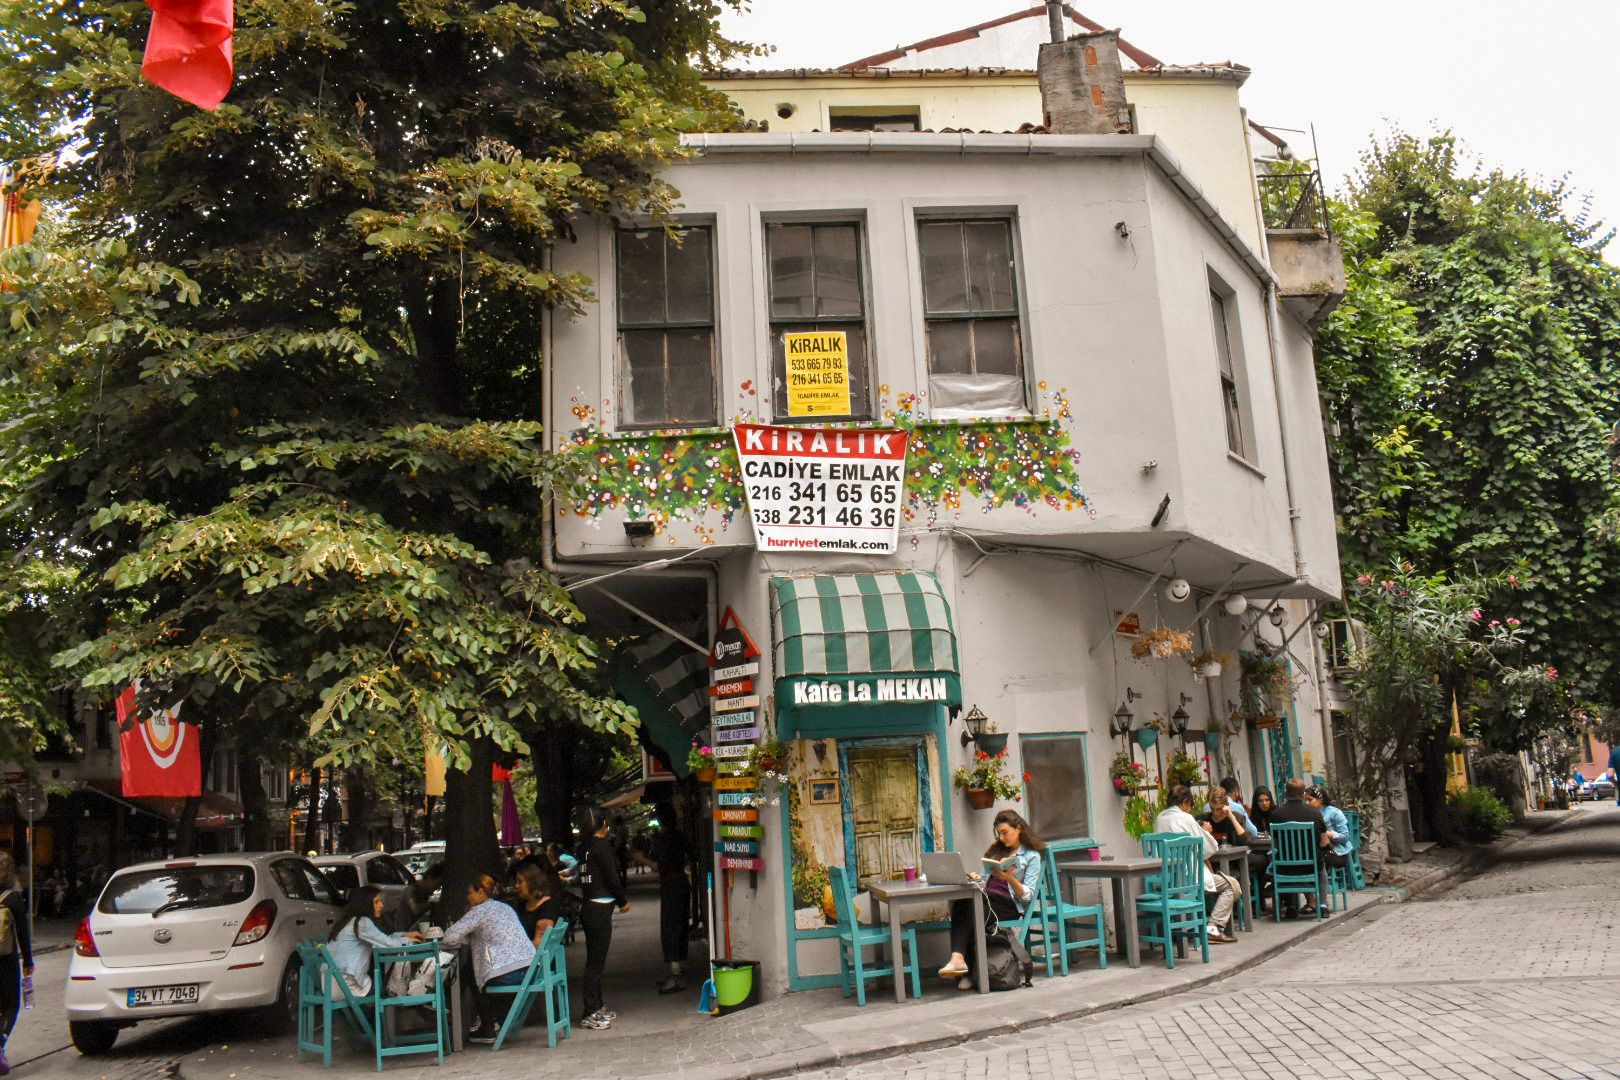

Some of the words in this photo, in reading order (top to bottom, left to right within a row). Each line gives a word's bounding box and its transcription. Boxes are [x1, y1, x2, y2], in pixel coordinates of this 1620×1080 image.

[791, 359, 806, 370] 533
[806, 358, 821, 370] 665
[822, 358, 832, 370] 79
[832, 357, 842, 369] 93
[792, 374, 806, 385] 216
[808, 373, 821, 384] 341
[823, 373, 833, 384] 65
[834, 372, 843, 384] 65
[821, 391, 840, 399] EMLAK
[829, 463, 901, 482] EMLAK
[788, 482, 827, 503] 341
[836, 483, 863, 504] 65
[870, 484, 897, 504] 65
[788, 505, 827, 526] 231
[835, 506, 863, 527] 46
[870, 507, 896, 528] 36
[767, 536, 889, 551] hurriyetemlak.com
[717, 682, 743, 695] MENEMEN
[794, 681, 842, 704] Kafe
[848, 679, 872, 702] La
[877, 677, 947, 701] MEKAN
[727, 698, 745, 708] MANTI
[737, 843, 750, 853] SUYU
[135, 990, 147, 1002] 34
[152, 988, 164, 1001] VT
[169, 986, 196, 1000] 7048
